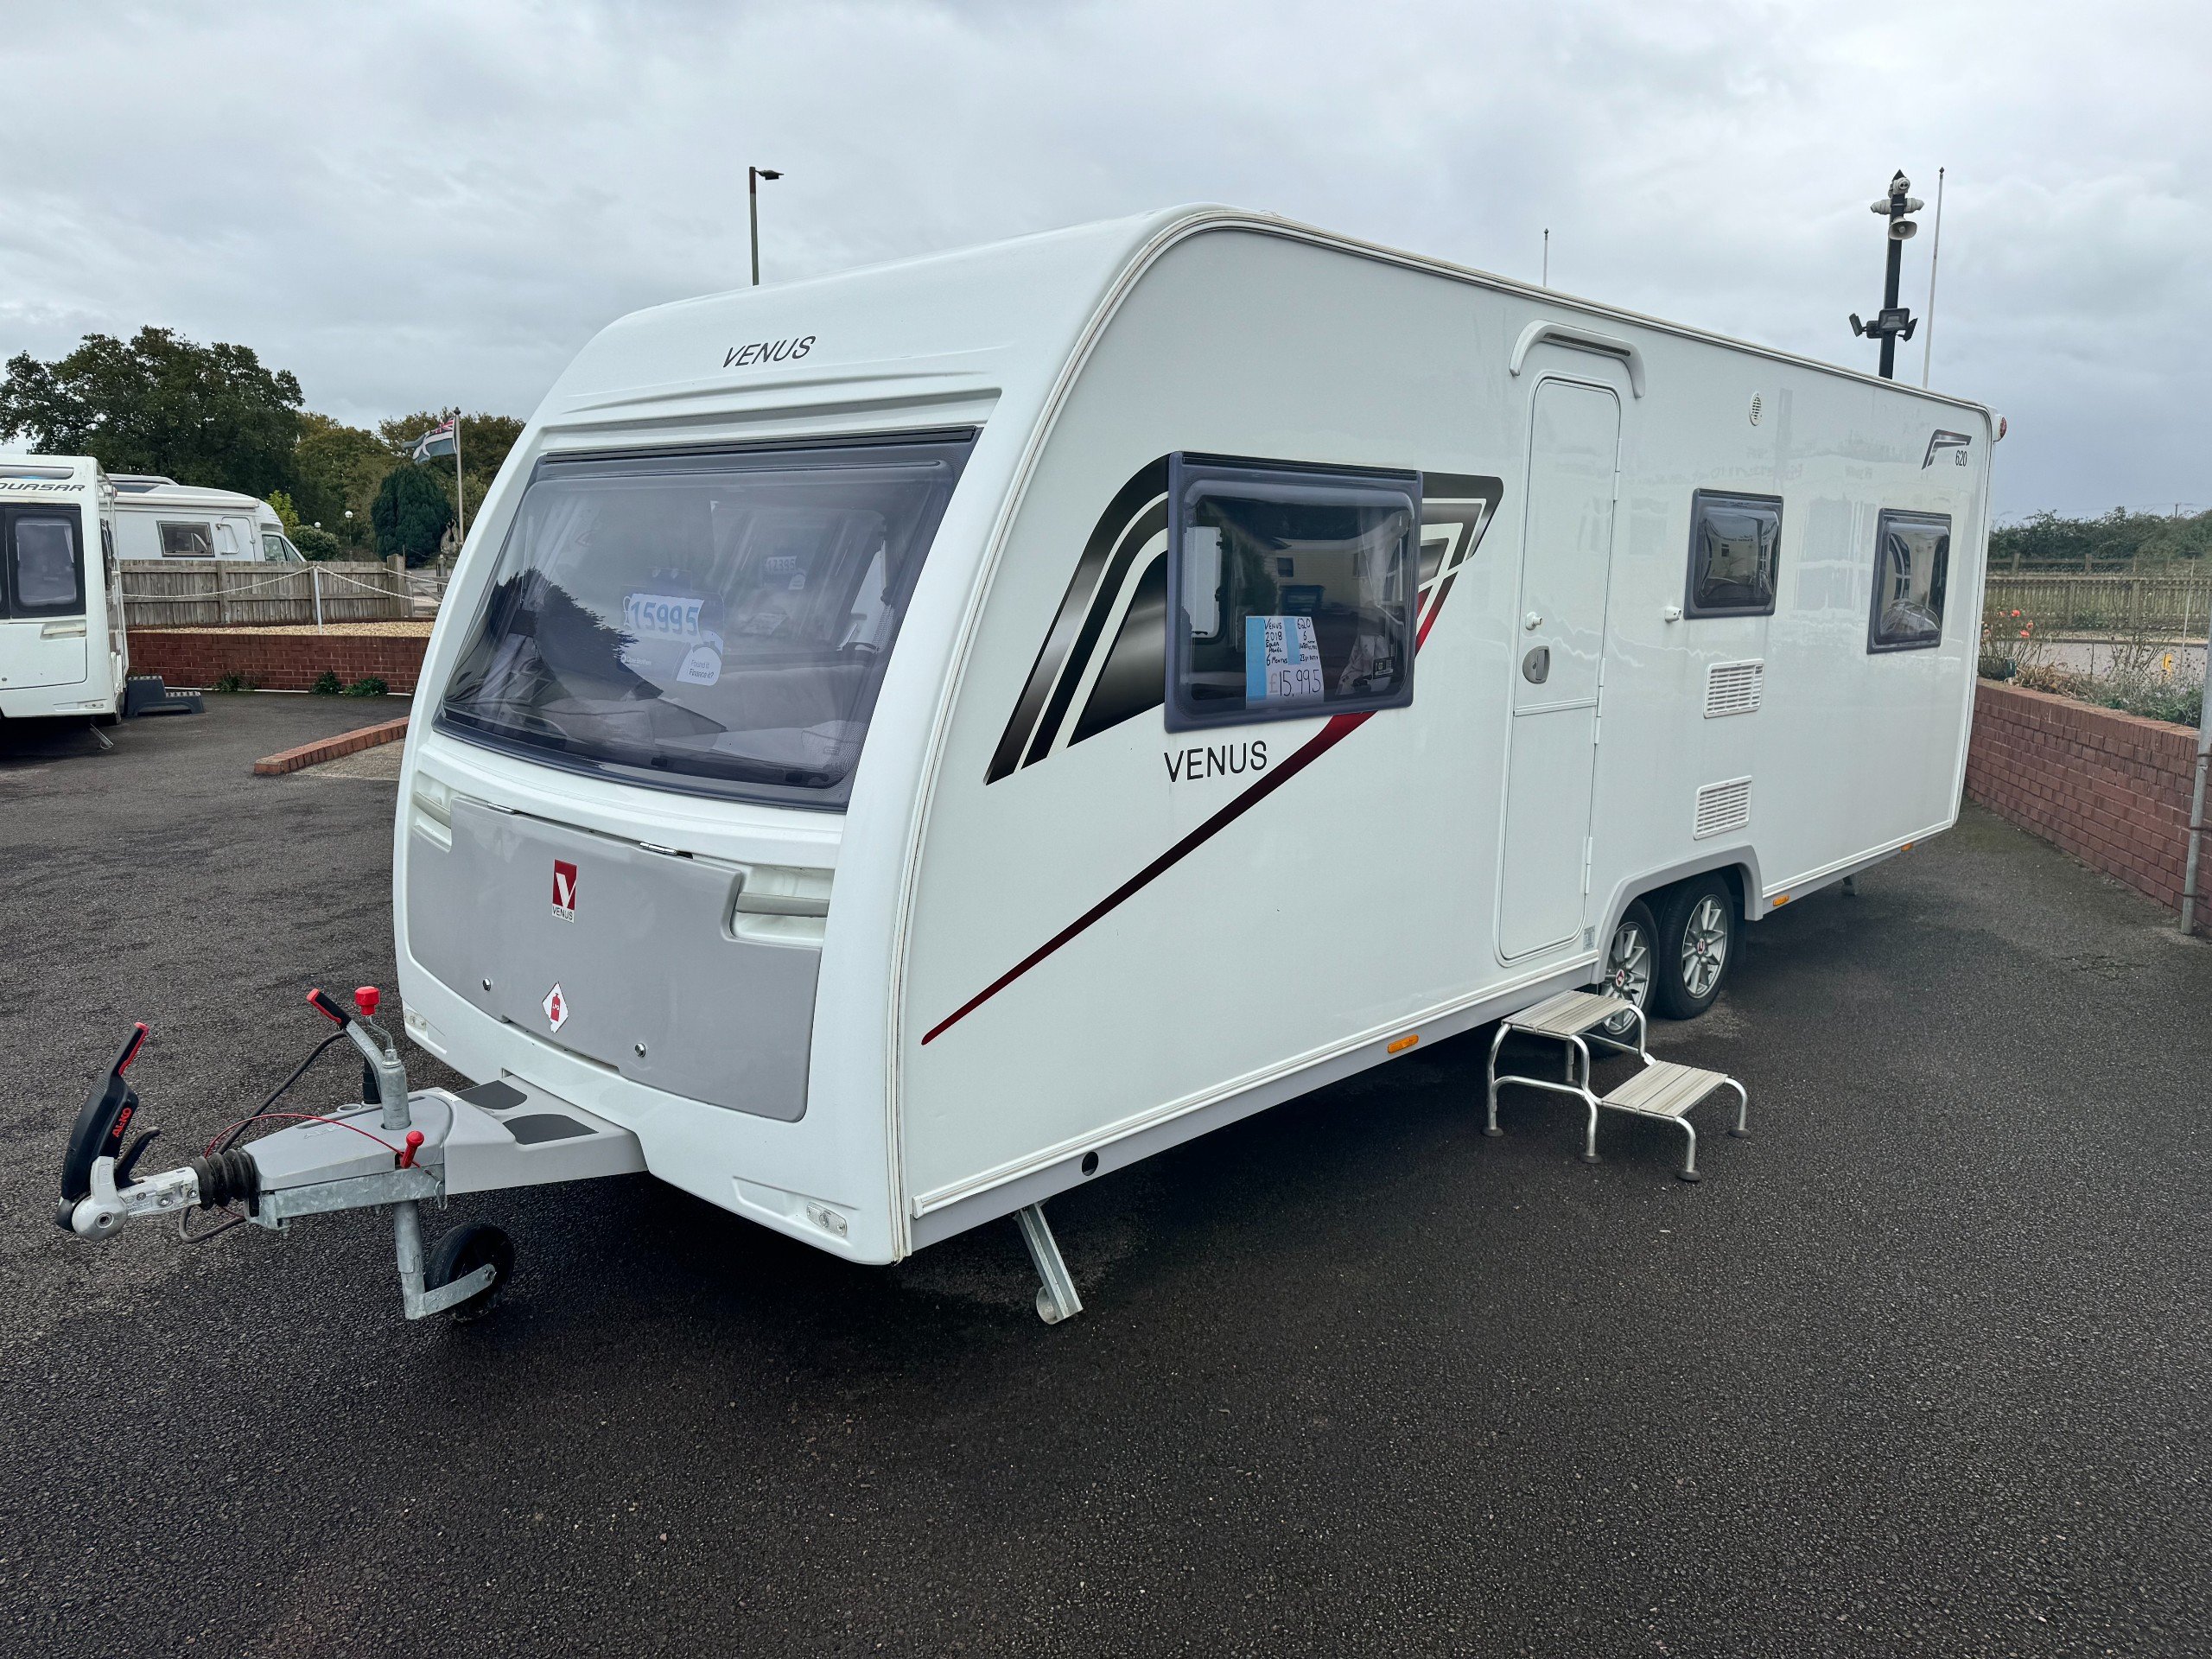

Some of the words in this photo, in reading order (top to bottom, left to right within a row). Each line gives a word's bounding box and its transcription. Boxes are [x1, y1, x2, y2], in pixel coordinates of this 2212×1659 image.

[723, 335, 817, 368] VENUS
[1955, 449, 1967, 467] 620
[1297, 618, 1311, 630] 620
[1265, 631, 1283, 641] 2018
[1303, 631, 1307, 641] 6
[1266, 653, 1271, 666] 6
[1163, 740, 1268, 783] VENUS
[552, 906, 574, 921] VENUS
[112, 1107, 132, 1139] AL-KO
